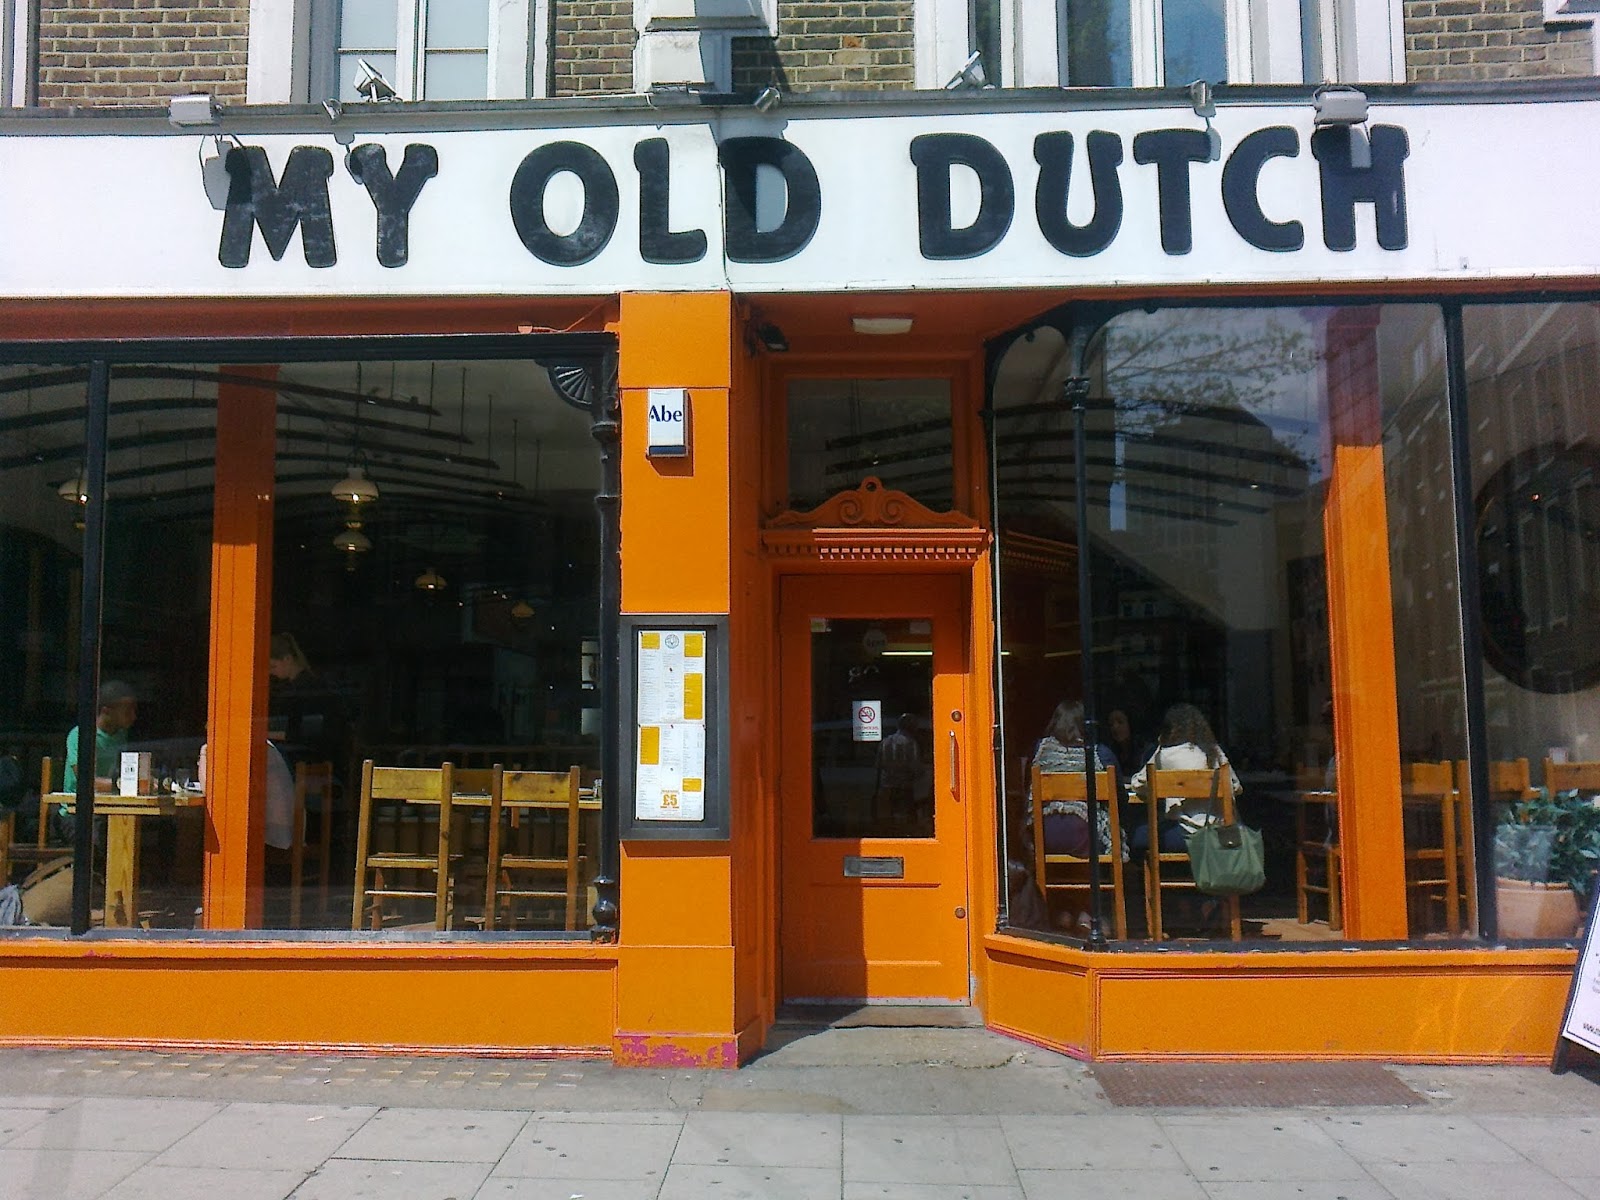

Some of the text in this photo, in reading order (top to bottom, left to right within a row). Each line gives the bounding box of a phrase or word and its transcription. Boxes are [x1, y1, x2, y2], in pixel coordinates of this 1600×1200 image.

[217, 124, 1410, 269] MY OLD DUTCH
[649, 404, 683, 423] Abe
[662, 794, 678, 806] £5
